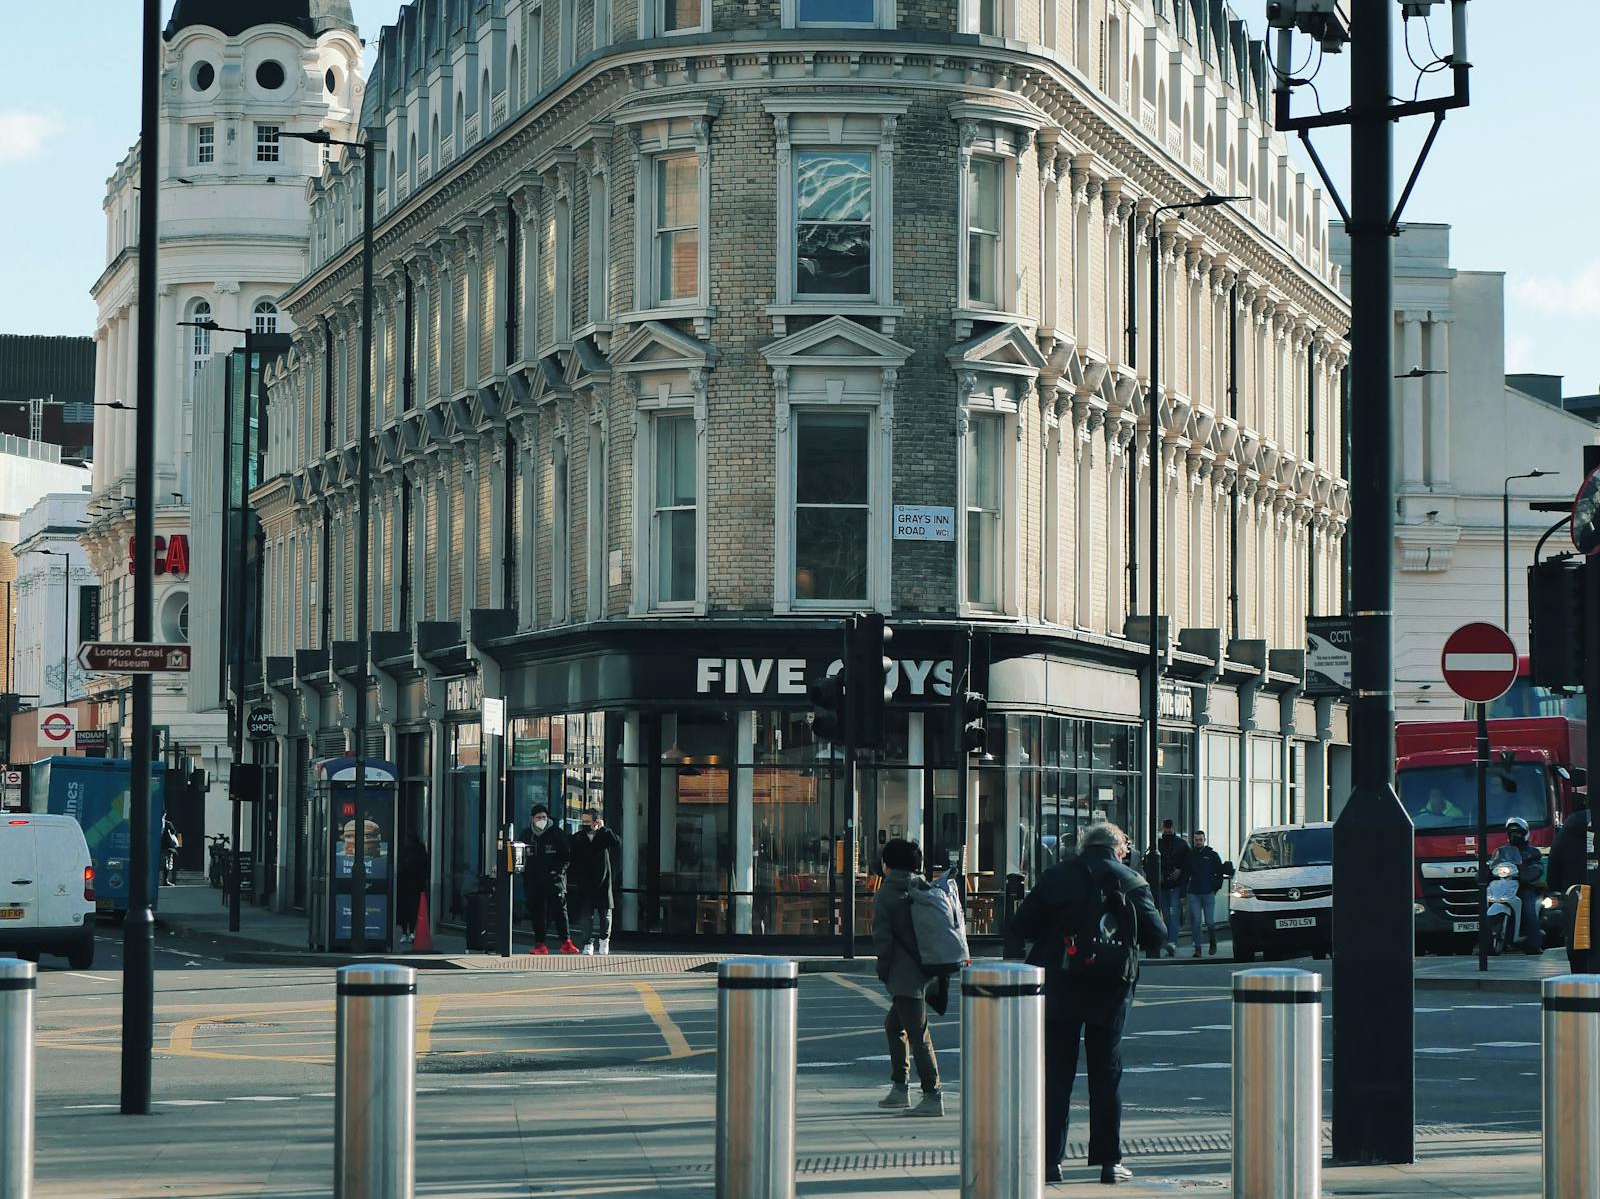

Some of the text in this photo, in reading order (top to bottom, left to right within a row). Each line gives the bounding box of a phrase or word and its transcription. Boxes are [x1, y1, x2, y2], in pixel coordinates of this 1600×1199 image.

[898, 514, 949, 524] GRAY'S INN
[898, 526, 925, 535] ROAD
[95, 647, 163, 658] London Canal
[108, 658, 150, 668] Museum
[696, 658, 953, 696] FIVE YS
[251, 714, 273, 722] VAPE
[1453, 866, 1478, 874] DA
